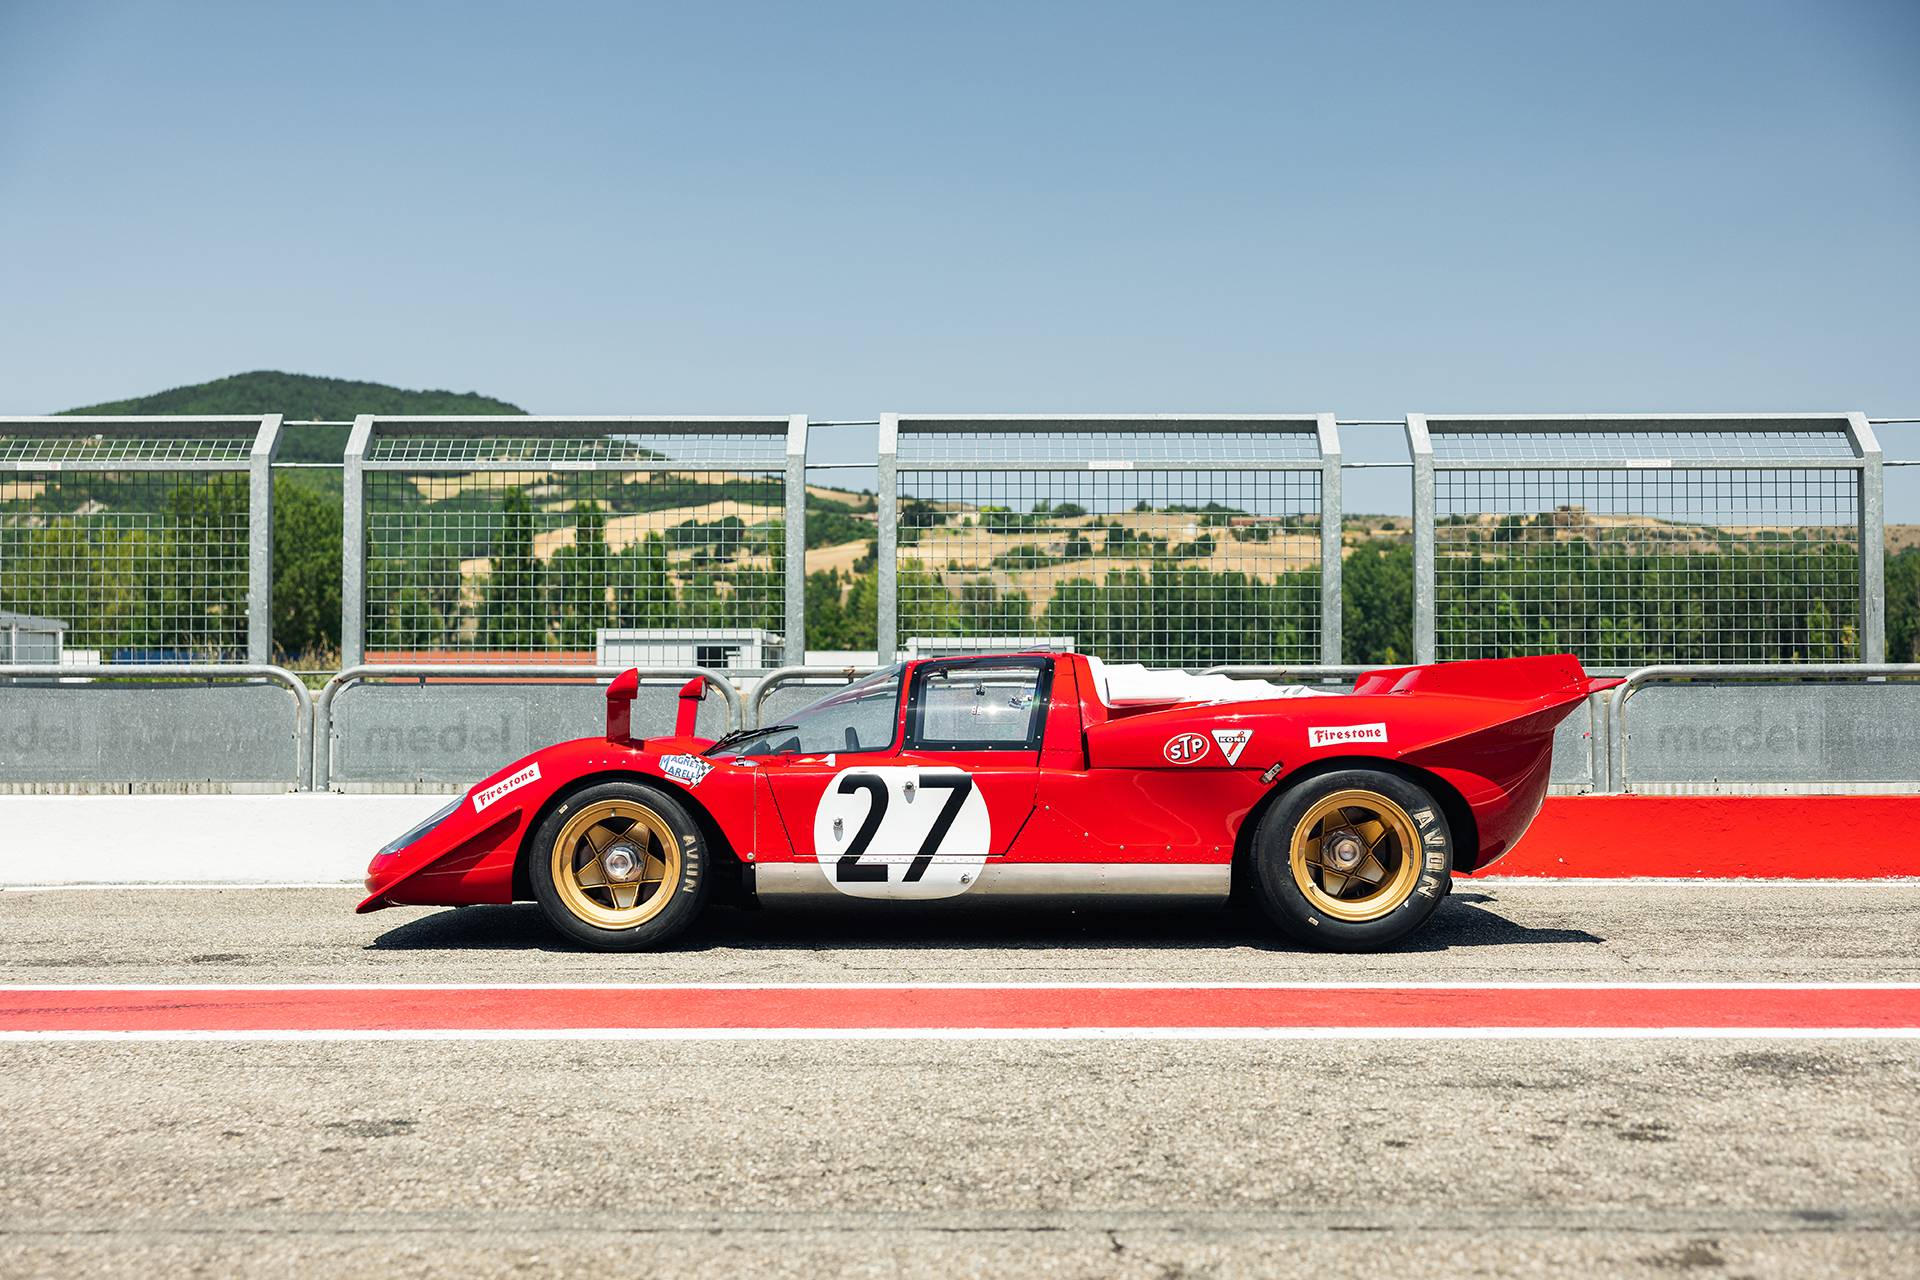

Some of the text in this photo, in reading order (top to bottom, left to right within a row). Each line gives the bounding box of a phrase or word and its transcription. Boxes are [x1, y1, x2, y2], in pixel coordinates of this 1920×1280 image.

[365, 711, 512, 754] medel
[1170, 735, 1204, 760] STP
[1314, 728, 1382, 744] Firestone
[1658, 709, 1808, 754] medel
[478, 769, 535, 806] Firestone
[836, 773, 973, 882] 27
[683, 834, 699, 894] AVON
[1412, 808, 1446, 898] AVON
